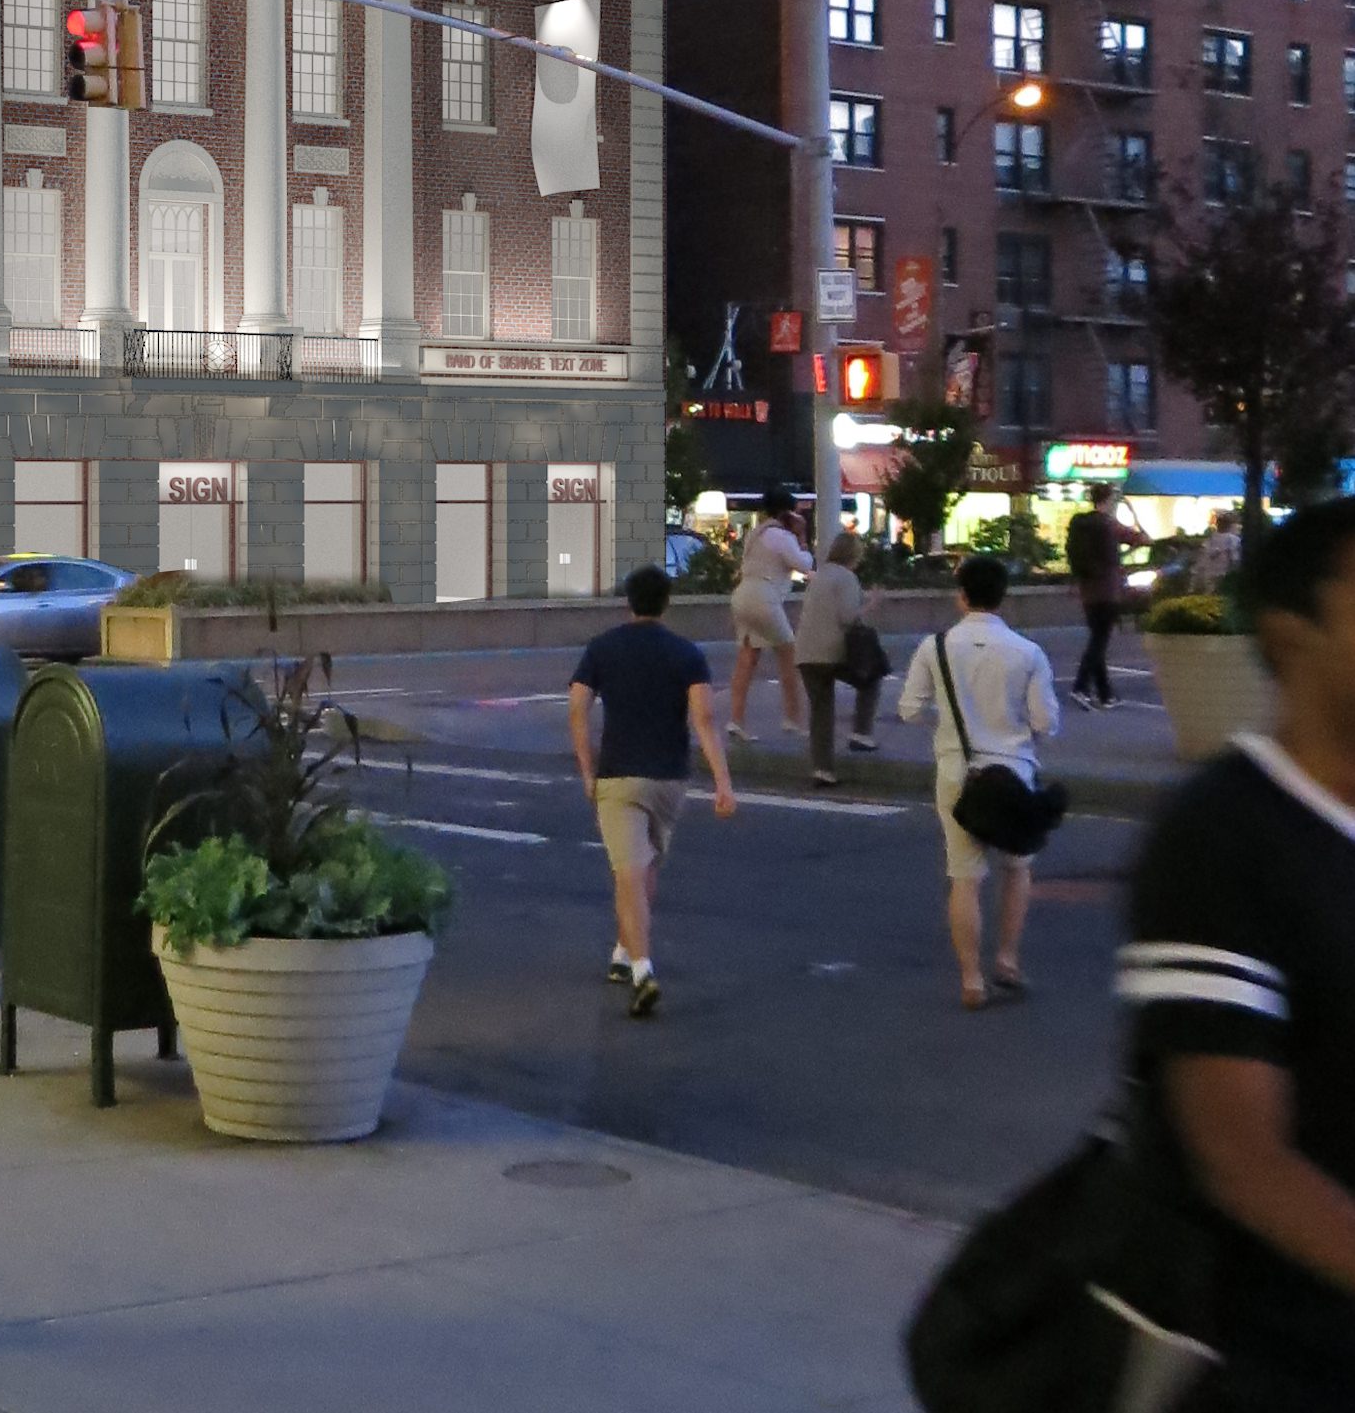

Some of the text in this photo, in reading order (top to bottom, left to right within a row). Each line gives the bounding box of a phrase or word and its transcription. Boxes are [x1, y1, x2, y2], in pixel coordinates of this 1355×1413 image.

[479, 355, 495, 370] OF
[548, 357, 576, 372] TEXT
[579, 358, 608, 373] ZONE
[168, 476, 228, 502] SIGN
[552, 478, 597, 501] SIGN
